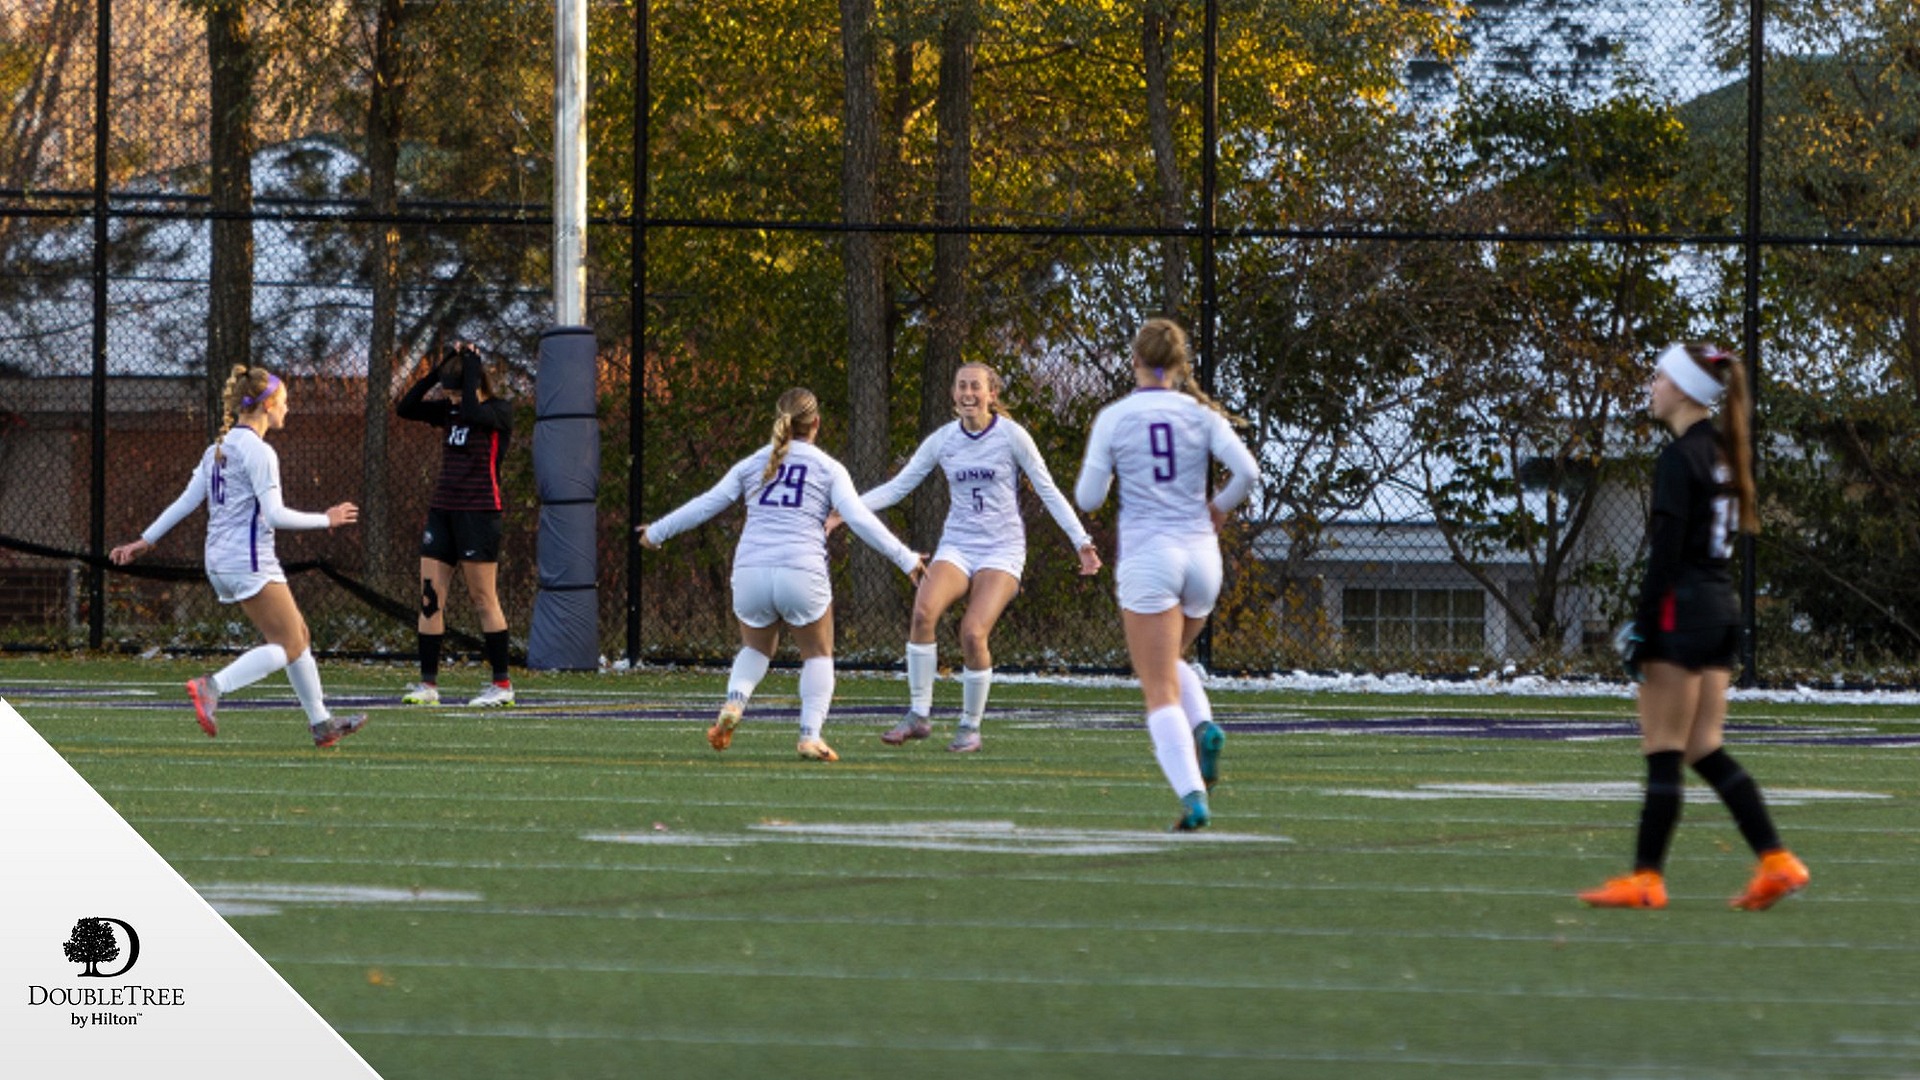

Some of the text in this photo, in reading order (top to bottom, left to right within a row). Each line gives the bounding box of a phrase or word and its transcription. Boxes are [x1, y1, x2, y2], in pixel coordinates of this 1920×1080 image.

[1149, 423, 1175, 482] 9
[759, 463, 808, 507] 29
[972, 487, 984, 513] 5
